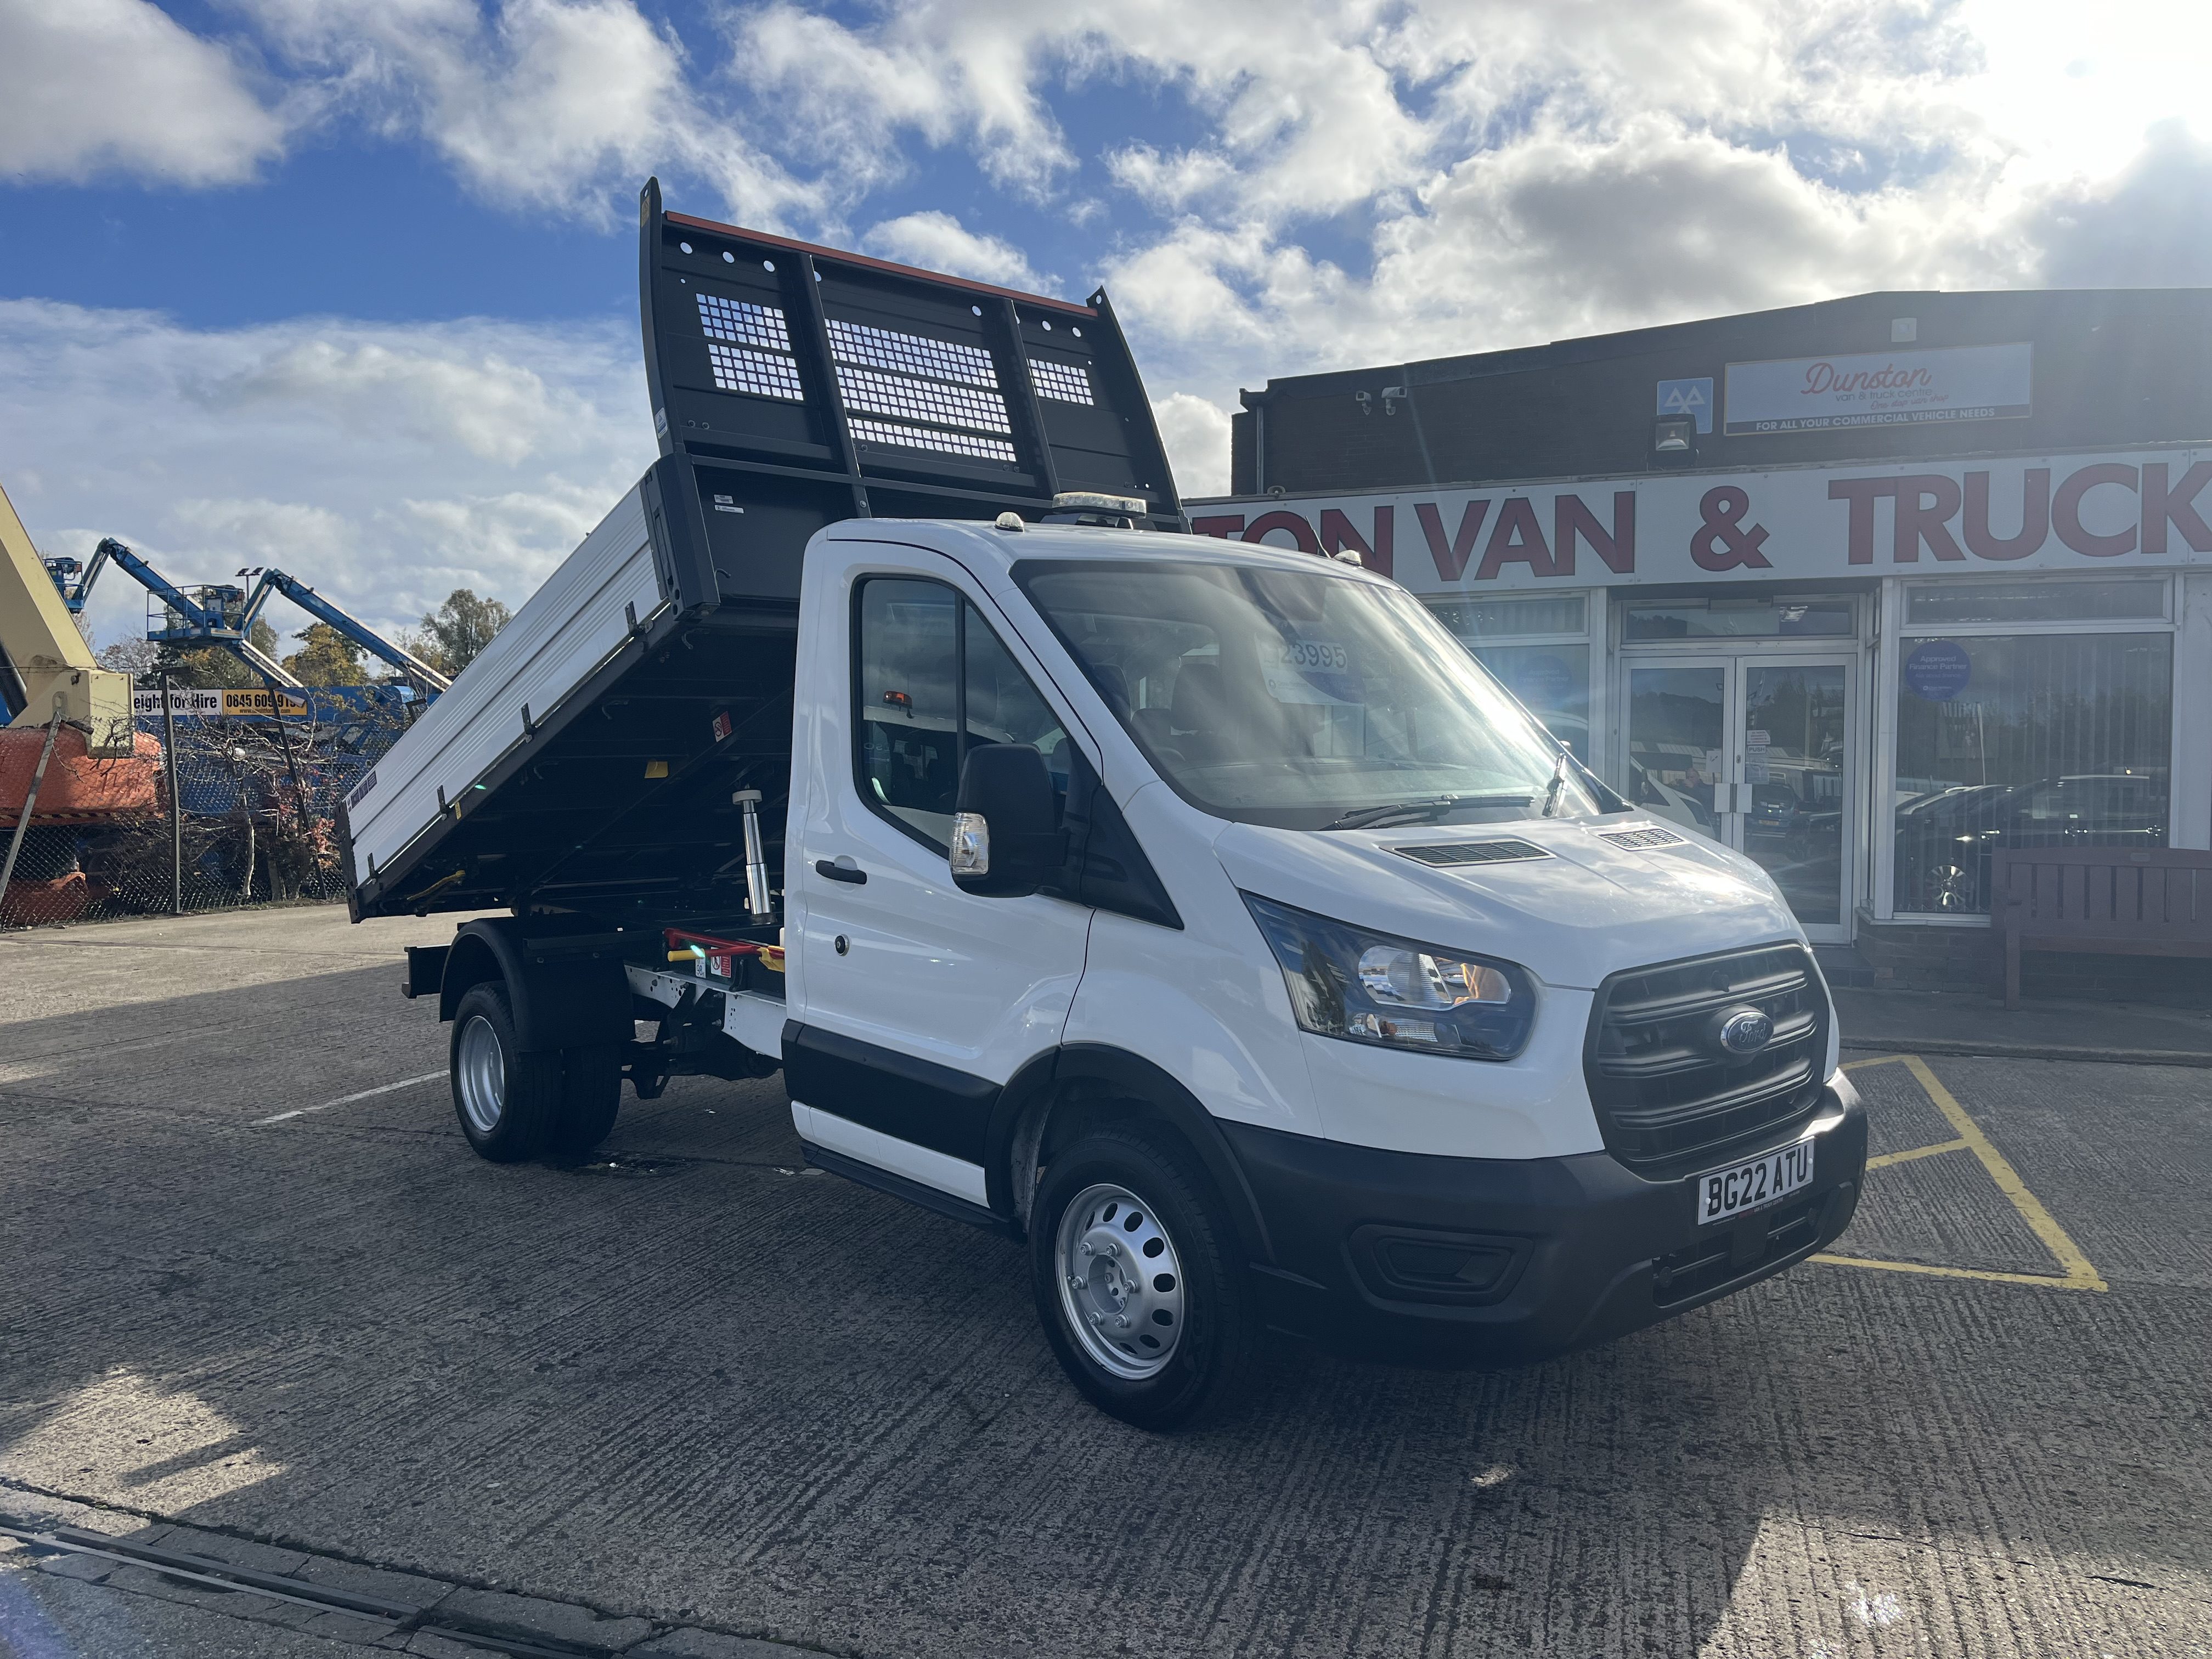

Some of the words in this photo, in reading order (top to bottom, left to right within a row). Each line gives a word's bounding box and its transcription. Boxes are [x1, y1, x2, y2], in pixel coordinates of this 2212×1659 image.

[1800, 362, 1933, 395] Dunston
[1836, 393, 1855, 402] van
[1859, 391, 1866, 400] &
[1870, 390, 1895, 399] truck
[1898, 388, 1933, 398] centre
[1756, 421, 1777, 431] FOR
[1780, 420, 1798, 430] ALL
[1800, 418, 1830, 428] YOUR
[1832, 413, 1909, 426] COMMERCIAL
[1911, 410, 1956, 421] VEHICLE
[1960, 408, 1995, 419] NEEDS
[1413, 490, 1635, 582] VAN
[1690, 485, 1774, 573] &
[1828, 461, 2212, 566] TRUCK
[1920, 656, 1956, 664] Approved
[134, 694, 163, 712] eigh
[227, 694, 252, 708] 0845
[1739, 1020, 1767, 1043] Ford
[1707, 1162, 1767, 1217] BG22
[1773, 1146, 1808, 1194] ATU
